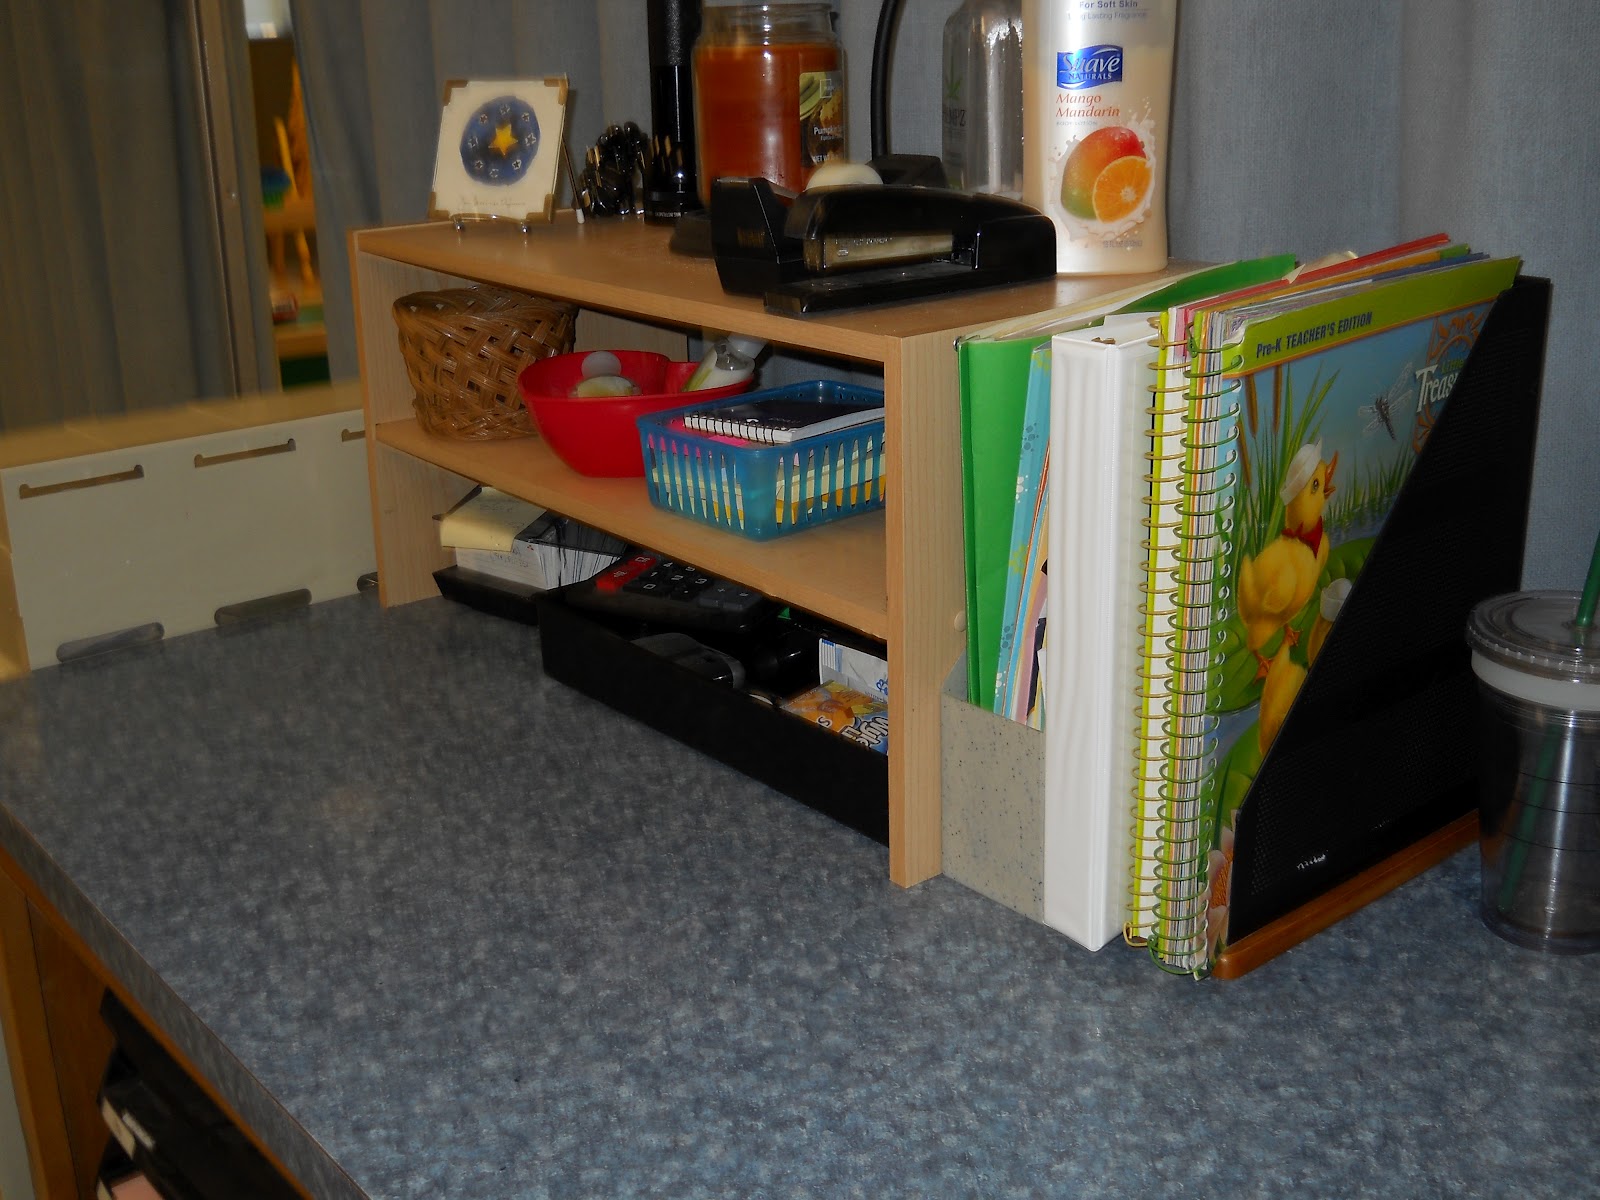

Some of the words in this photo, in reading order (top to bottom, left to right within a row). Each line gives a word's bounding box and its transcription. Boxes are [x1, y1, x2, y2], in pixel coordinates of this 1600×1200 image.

[1097, 0, 1116, 8] Soft
[1060, 53, 1120, 73] Suave
[1068, 72, 1112, 80] NATURALS
[1056, 93, 1102, 107] Mango
[1056, 105, 1120, 118] Mandarin
[1256, 337, 1282, 359] Pre-K
[1286, 321, 1335, 350] TEACHER'S
[1338, 311, 1373, 334] EDITION
[1415, 364, 1459, 413] Treas
